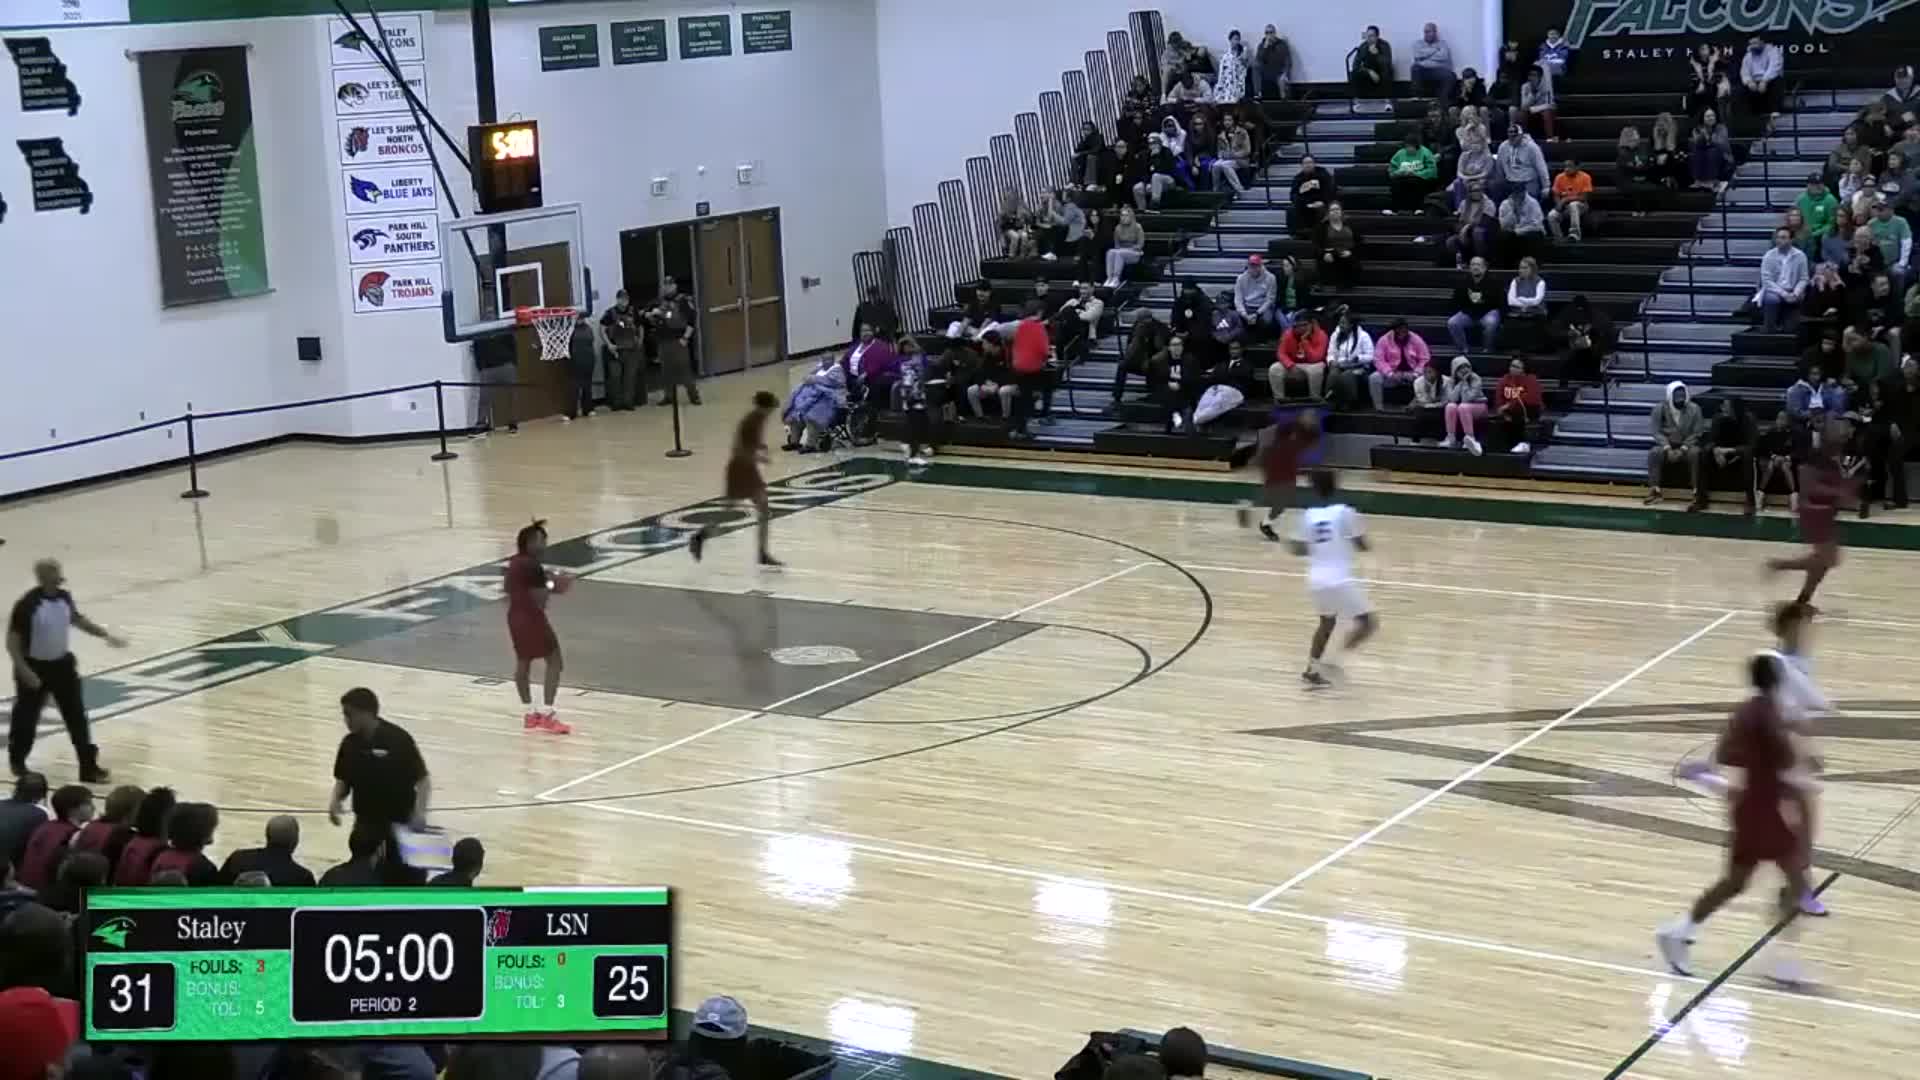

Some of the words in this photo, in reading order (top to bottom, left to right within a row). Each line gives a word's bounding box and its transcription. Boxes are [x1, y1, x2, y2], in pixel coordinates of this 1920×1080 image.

[1563, 0, 1873, 49] FALCONS
[1602, 48, 1674, 59] STALEY
[367, 80, 390, 90] LEE'S
[371, 126, 394, 135] LEE'S
[386, 134, 414, 144] NORTH
[377, 143, 425, 156] BRONCOS
[391, 178, 424, 188] LIBERTY
[383, 188, 409, 200] BLUE
[412, 186, 433, 198] JAYS
[388, 222, 409, 232] PARK
[410, 221, 428, 230] HILL
[395, 231, 423, 241] SOUTH
[383, 240, 436, 254] PANTHERS
[392, 279, 413, 288] PARK
[415, 277, 433, 286] HILL
[391, 285, 435, 299] TROJANS
